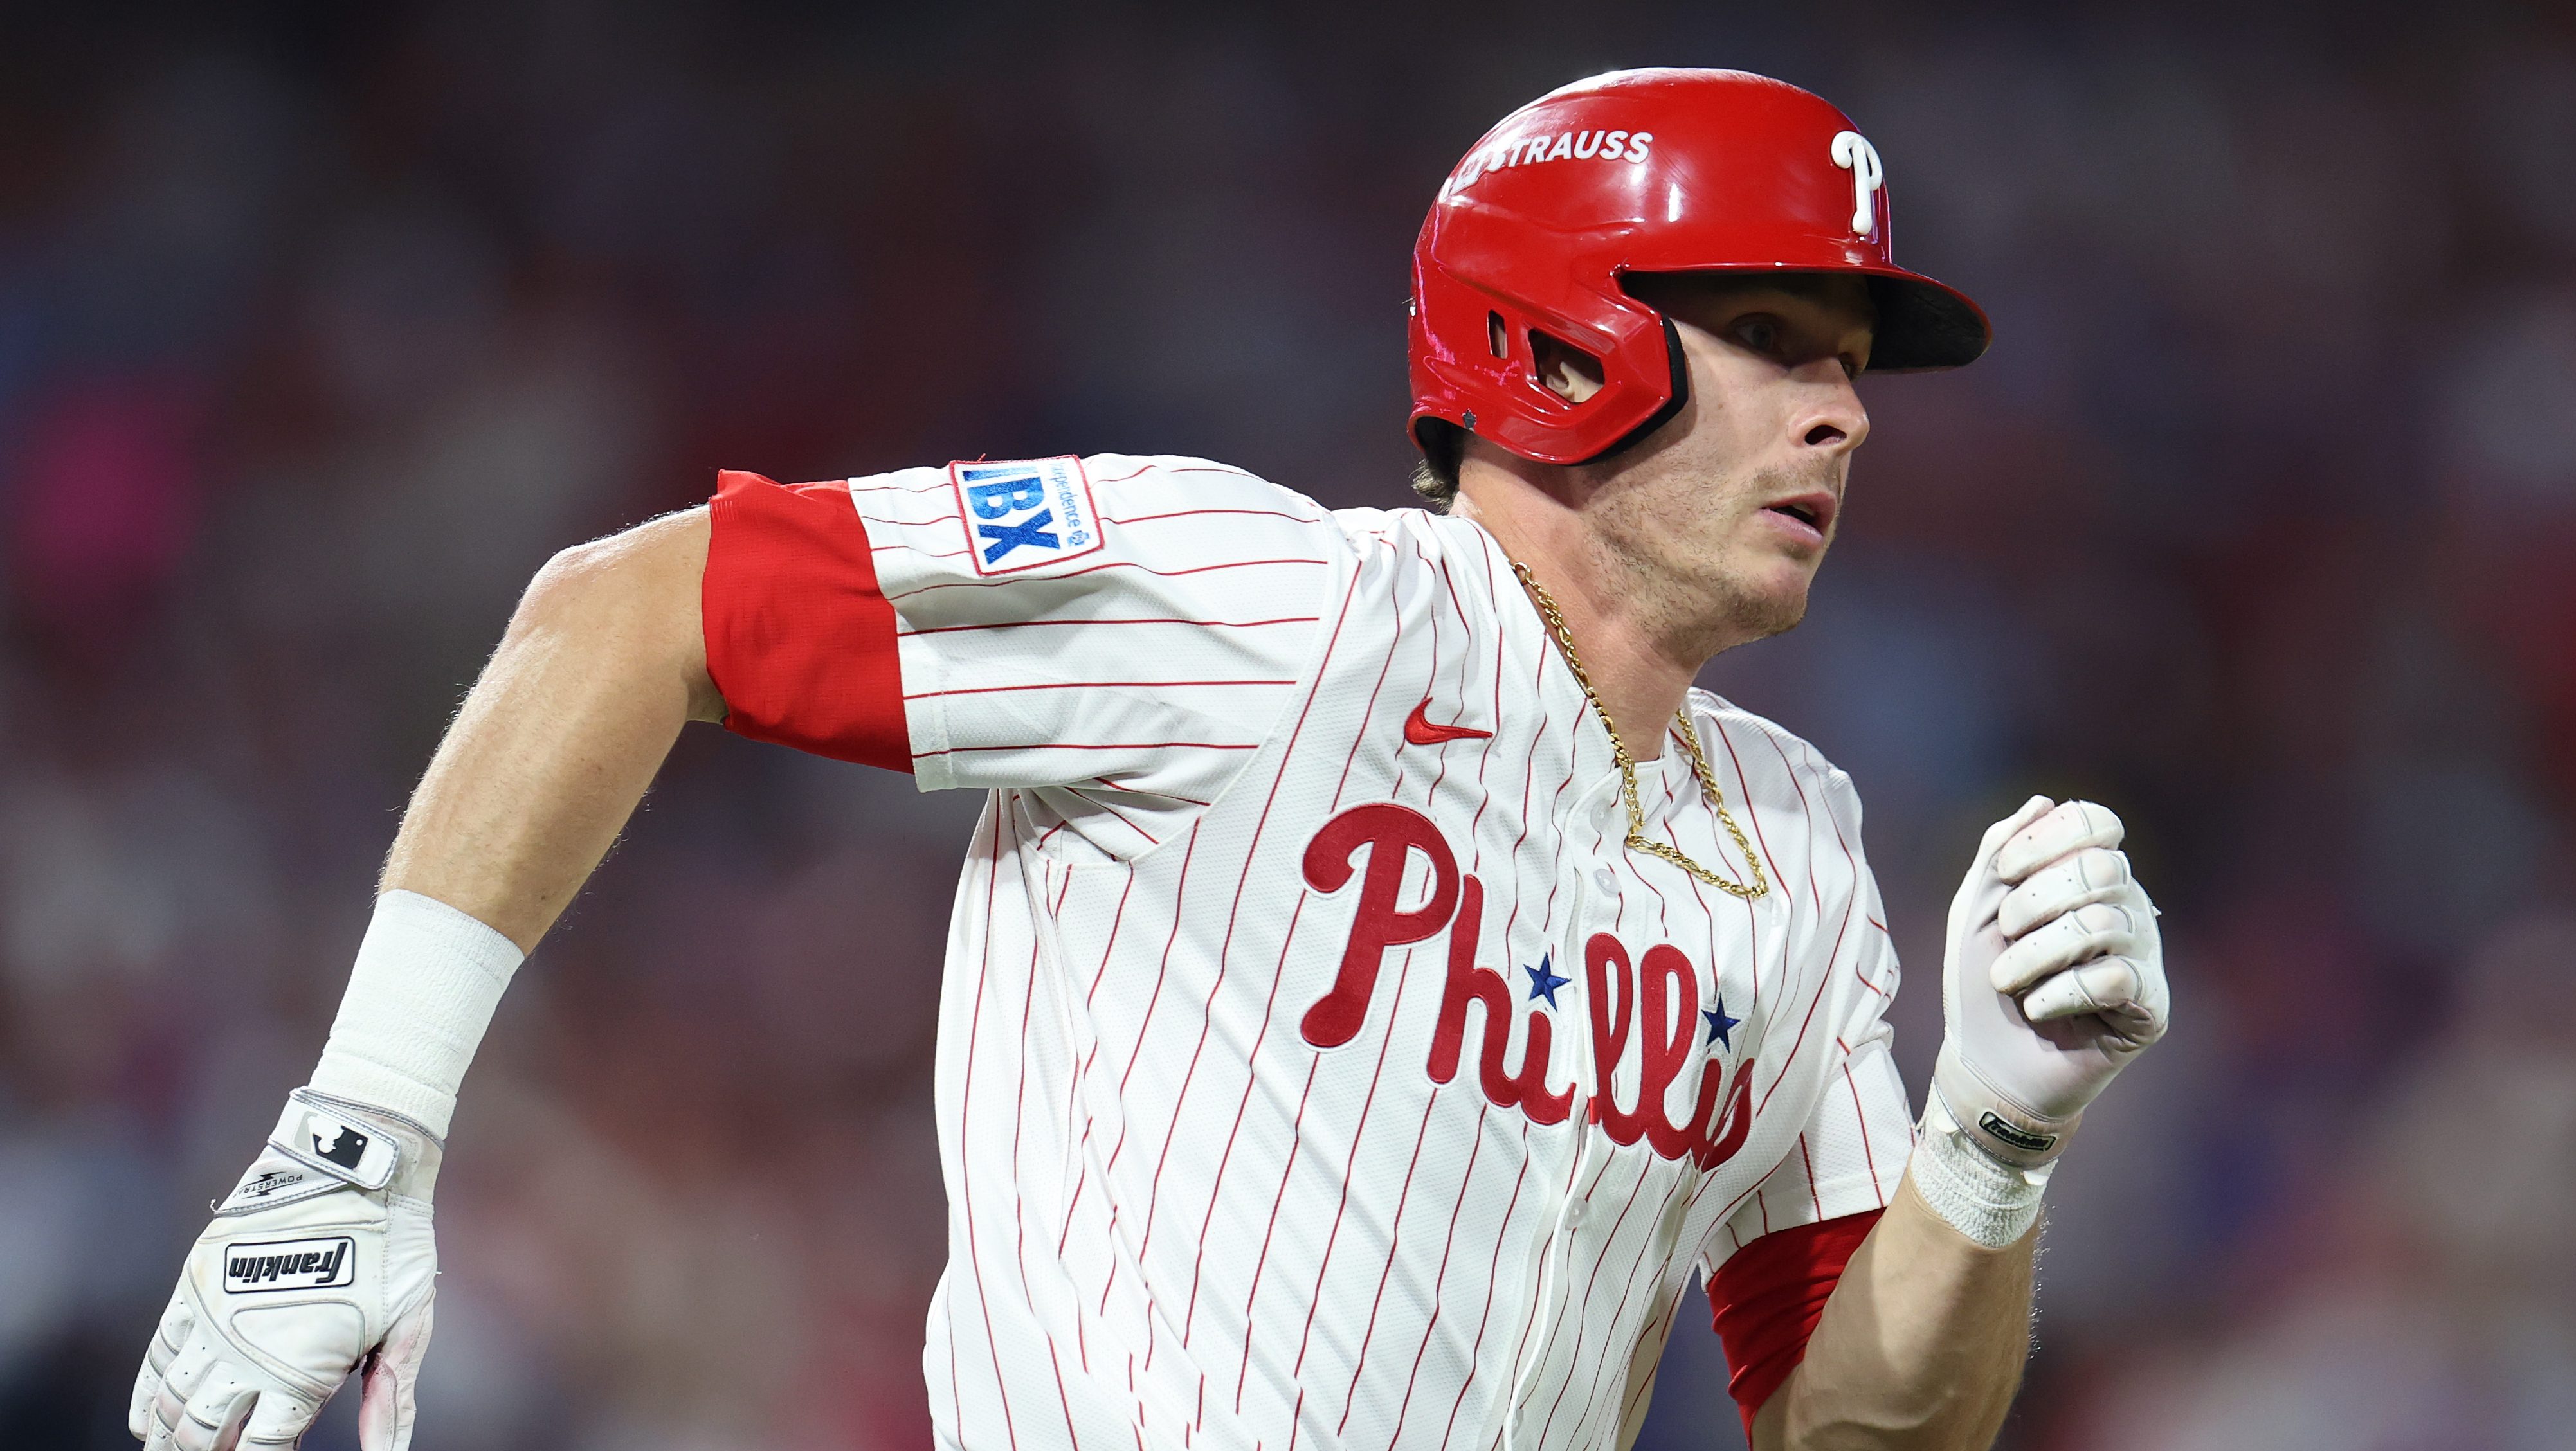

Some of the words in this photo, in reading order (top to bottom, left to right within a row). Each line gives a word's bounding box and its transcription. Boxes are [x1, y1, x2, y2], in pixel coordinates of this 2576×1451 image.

[1831, 131, 1883, 235] P
[962, 465, 1061, 565] IBX
[233, 1175, 303, 1198] POWERSTRA
[228, 1241, 348, 1284] franklin
